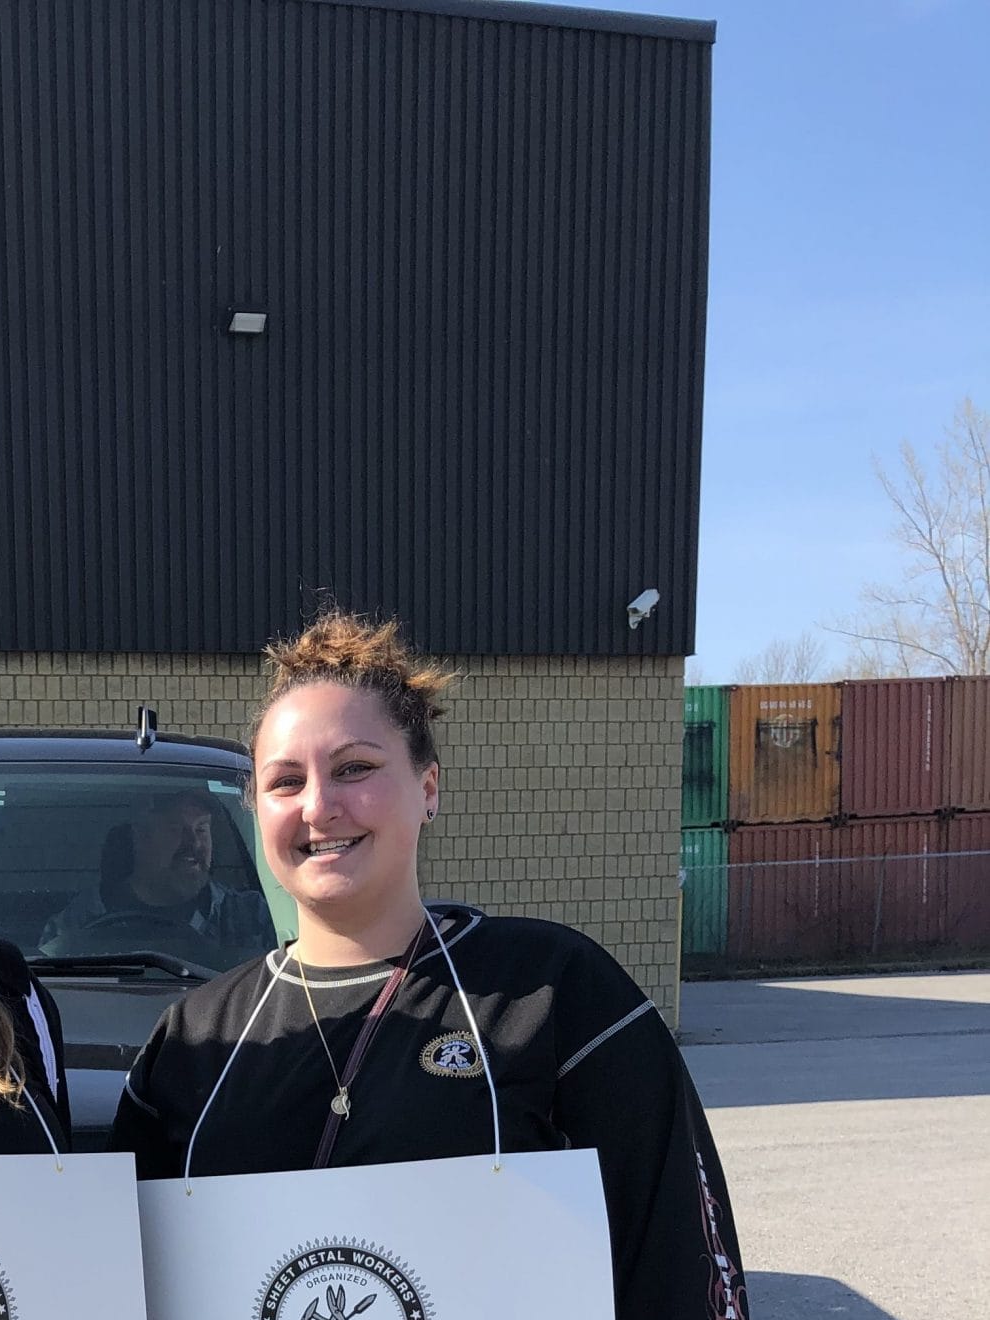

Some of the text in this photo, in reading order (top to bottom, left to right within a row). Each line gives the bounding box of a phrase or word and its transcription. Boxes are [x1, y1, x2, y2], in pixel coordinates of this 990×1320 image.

[266, 1250, 416, 1310] SHEET METAL WORKERS'
[306, 1273, 368, 1289] ORGANIZED
